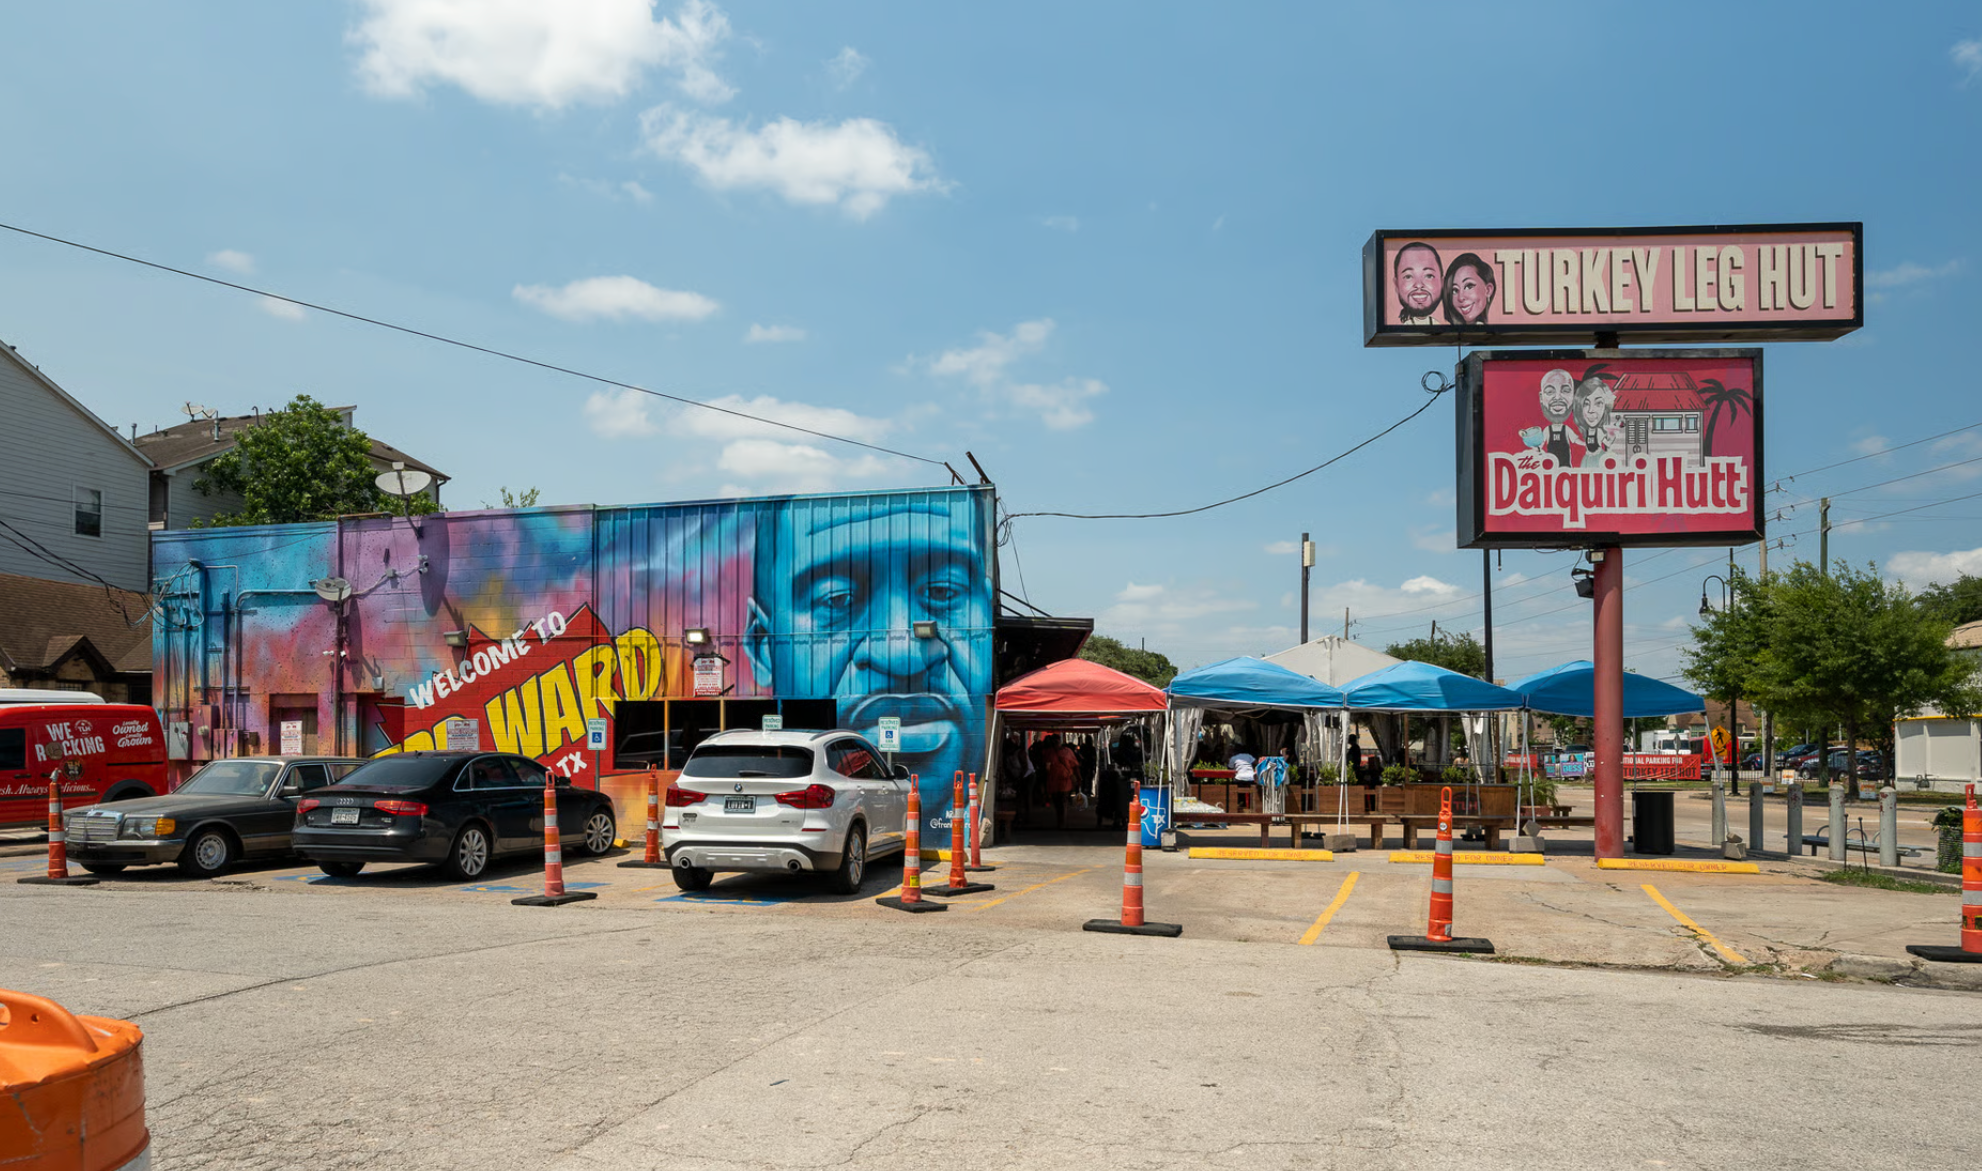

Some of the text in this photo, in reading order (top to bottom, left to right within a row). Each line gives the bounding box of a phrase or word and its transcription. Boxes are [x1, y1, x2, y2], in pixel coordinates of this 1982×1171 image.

[1495, 242, 1844, 315] TURKEY LEG HUT
[1517, 456, 1540, 470] the
[1494, 456, 1742, 522] Daiquiri Hutt
[409, 611, 567, 710] WELCOME TO
[484, 626, 663, 760] WARD
[46, 722, 74, 741] WE
[112, 721, 149, 735] Owned
[117, 736, 153, 748] Grown
[556, 751, 588, 778] TX
[1645, 756, 1672, 766] PARKING
[1672, 756, 1683, 765] FOR
[1624, 767, 1658, 778] TURKEY
[14, 783, 49, 795] Always
[1151, 814, 1166, 824] TX
[1217, 849, 1260, 858] RESERVED
[1627, 861, 1674, 869] RESERVED
[1700, 863, 1727, 871] OWNER
